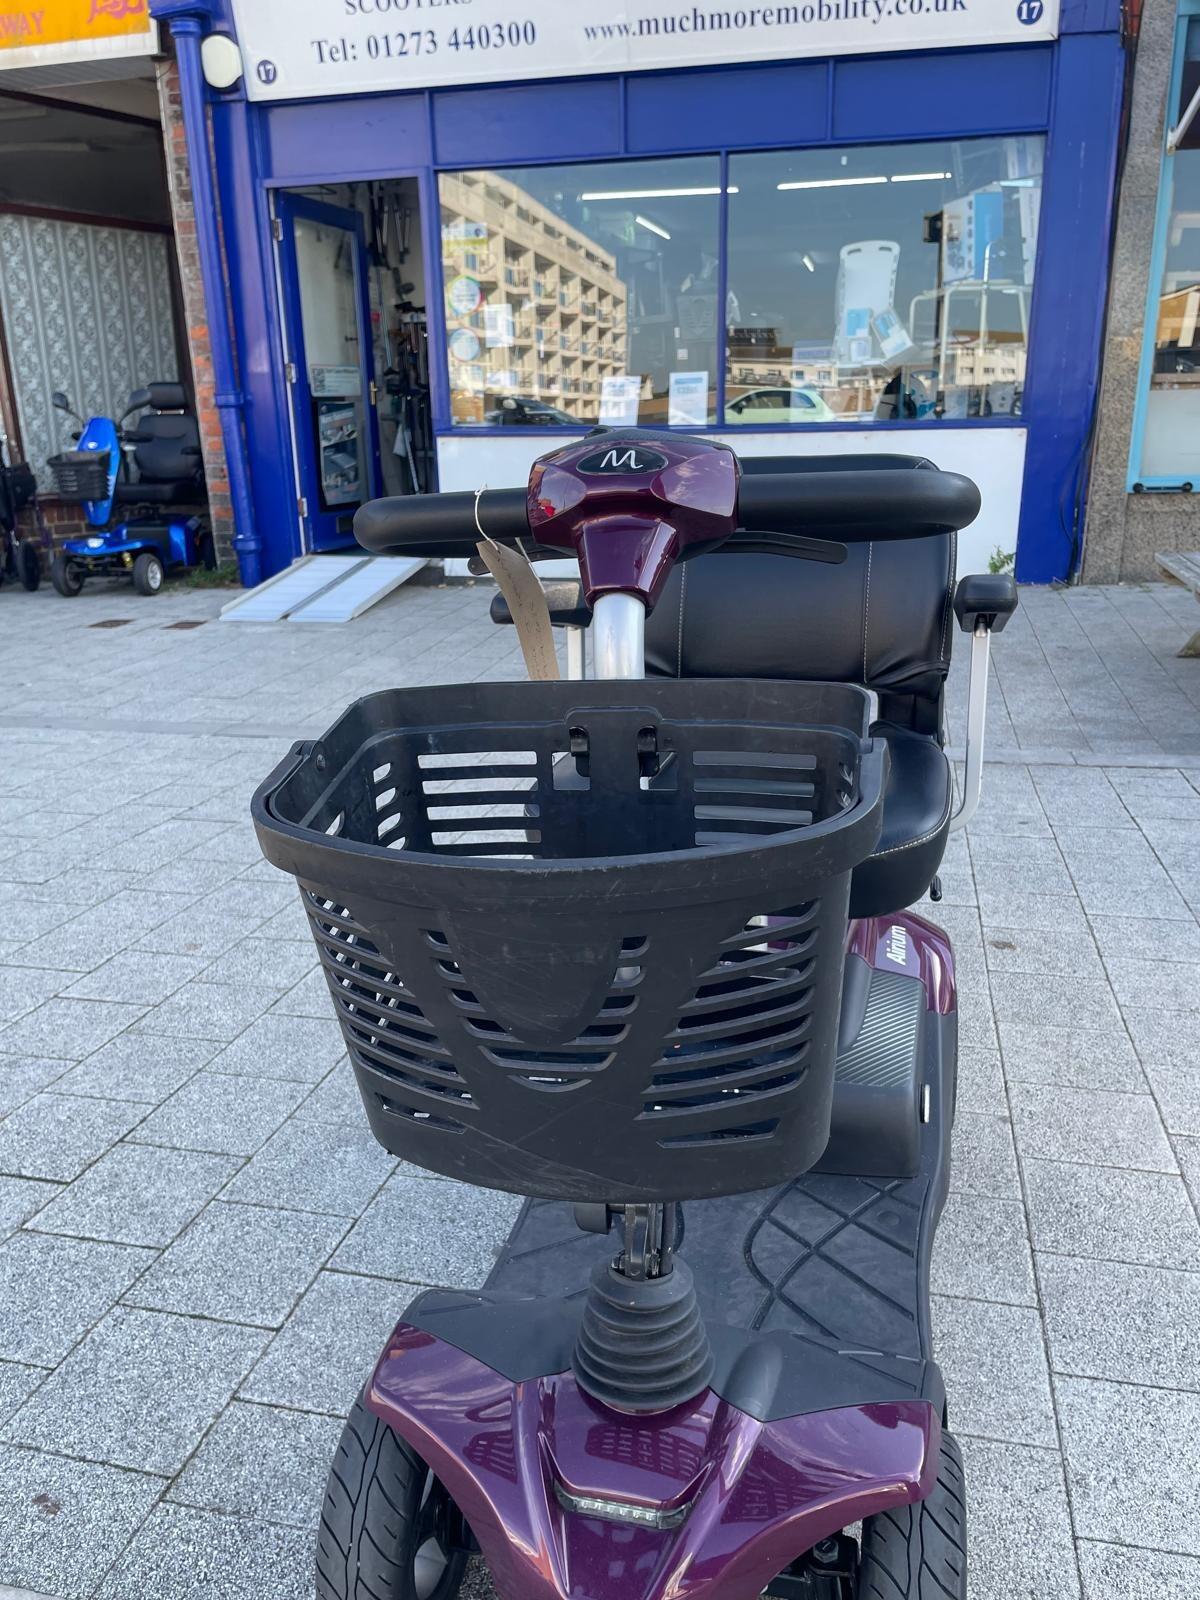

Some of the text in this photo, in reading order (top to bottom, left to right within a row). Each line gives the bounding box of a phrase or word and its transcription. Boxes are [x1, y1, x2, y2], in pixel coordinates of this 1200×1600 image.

[1018, 1, 1042, 21] 17
[311, 20, 536, 64] Tel: 01273 440300
[258, 62, 275, 82] 17
[886, 925, 906, 966] Airium
